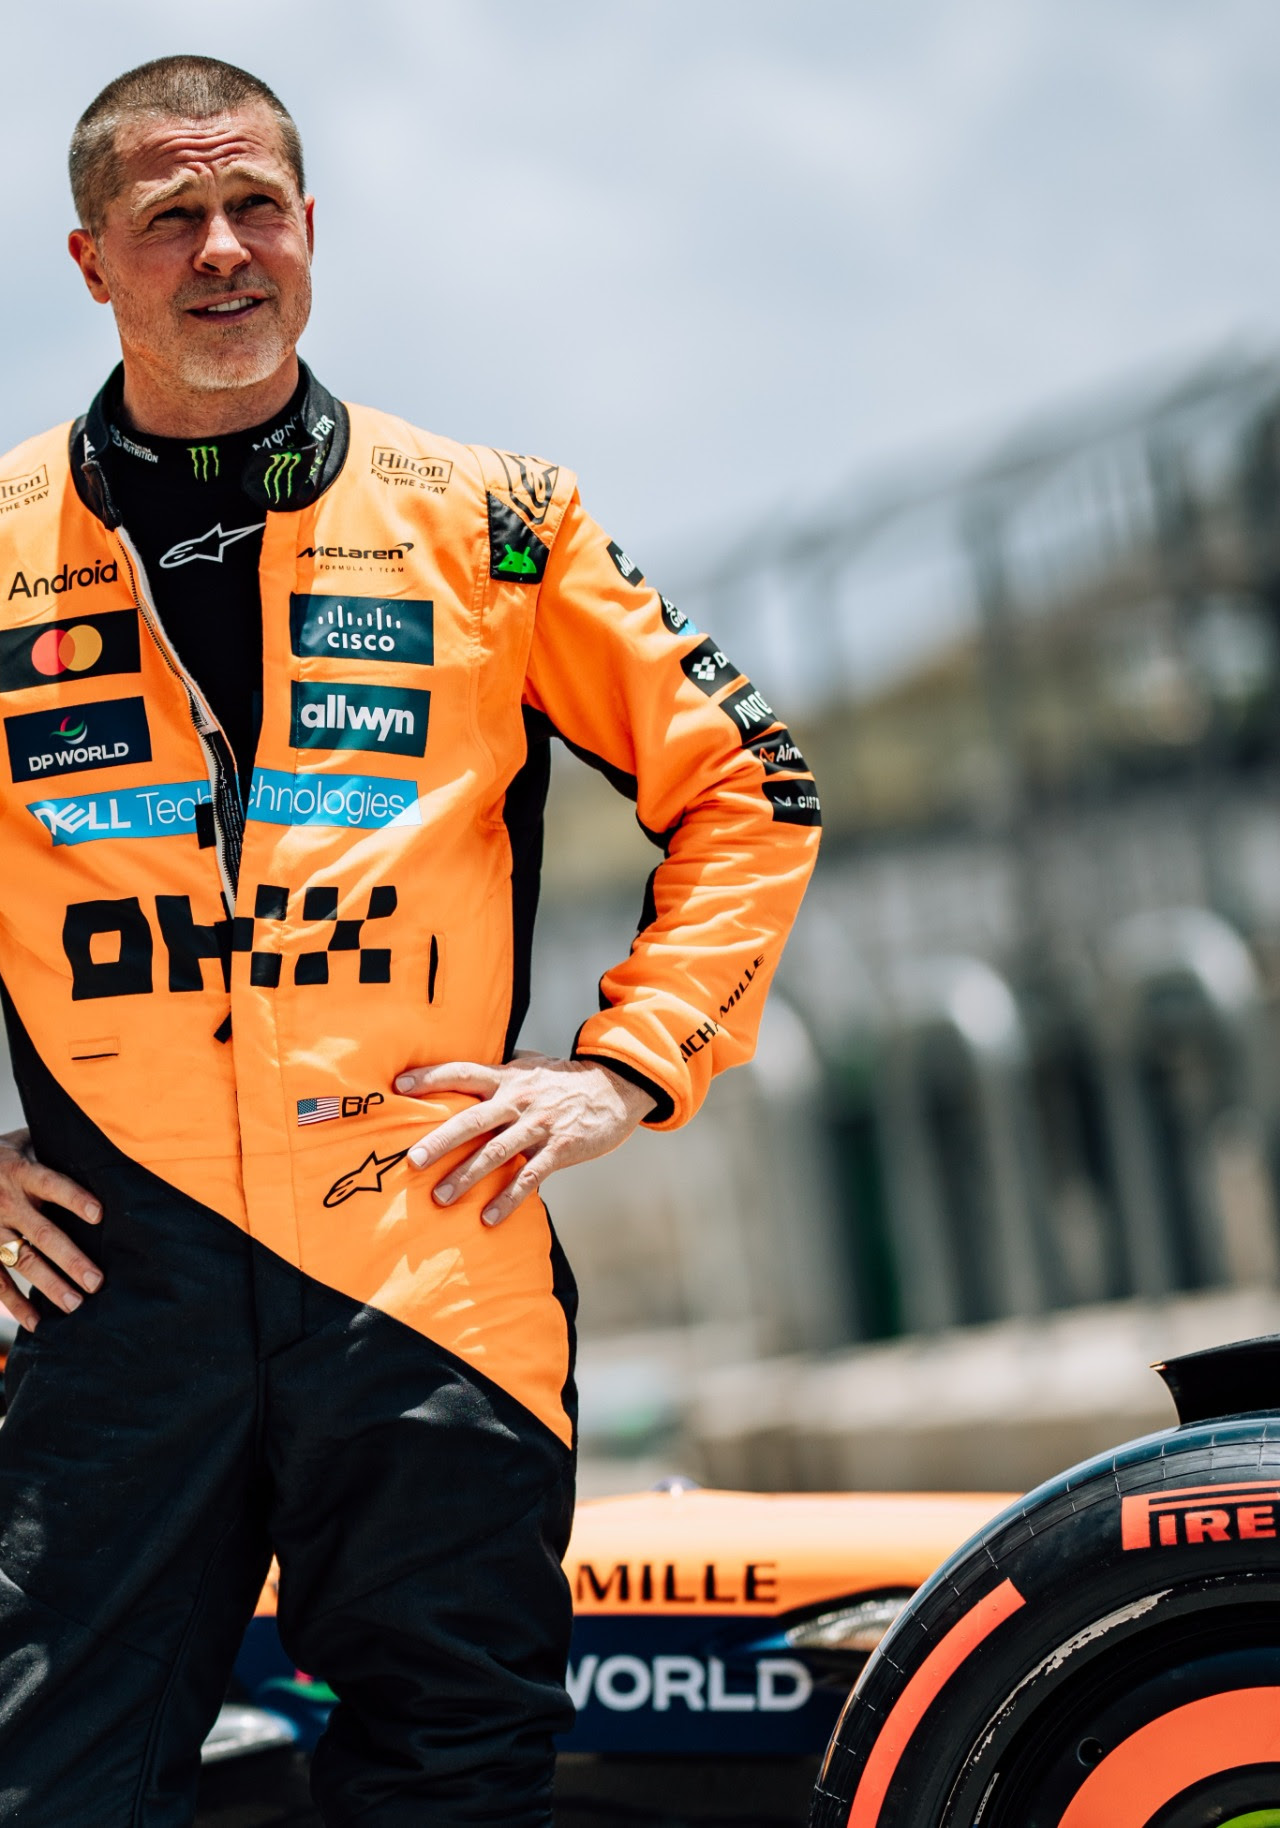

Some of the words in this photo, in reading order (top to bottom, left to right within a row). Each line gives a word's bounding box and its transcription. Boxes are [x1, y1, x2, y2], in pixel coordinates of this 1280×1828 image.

[378, 452, 444, 478] Hilton
[370, 468, 390, 485] FOR
[393, 478, 416, 487] THE
[419, 483, 447, 495] STAY
[23, 490, 50, 506] STAY
[296, 545, 404, 560] McLaren
[7, 559, 118, 602] Android
[319, 564, 364, 572] FORMULA
[326, 631, 396, 652] CISCO
[300, 694, 415, 742] allwyn
[28, 754, 54, 772] DP
[54, 742, 130, 766] WORLD
[34, 798, 132, 835] DELL
[719, 953, 766, 1019] MILLE
[341, 1092, 385, 1118] BP
[576, 1563, 778, 1604] MILLE
